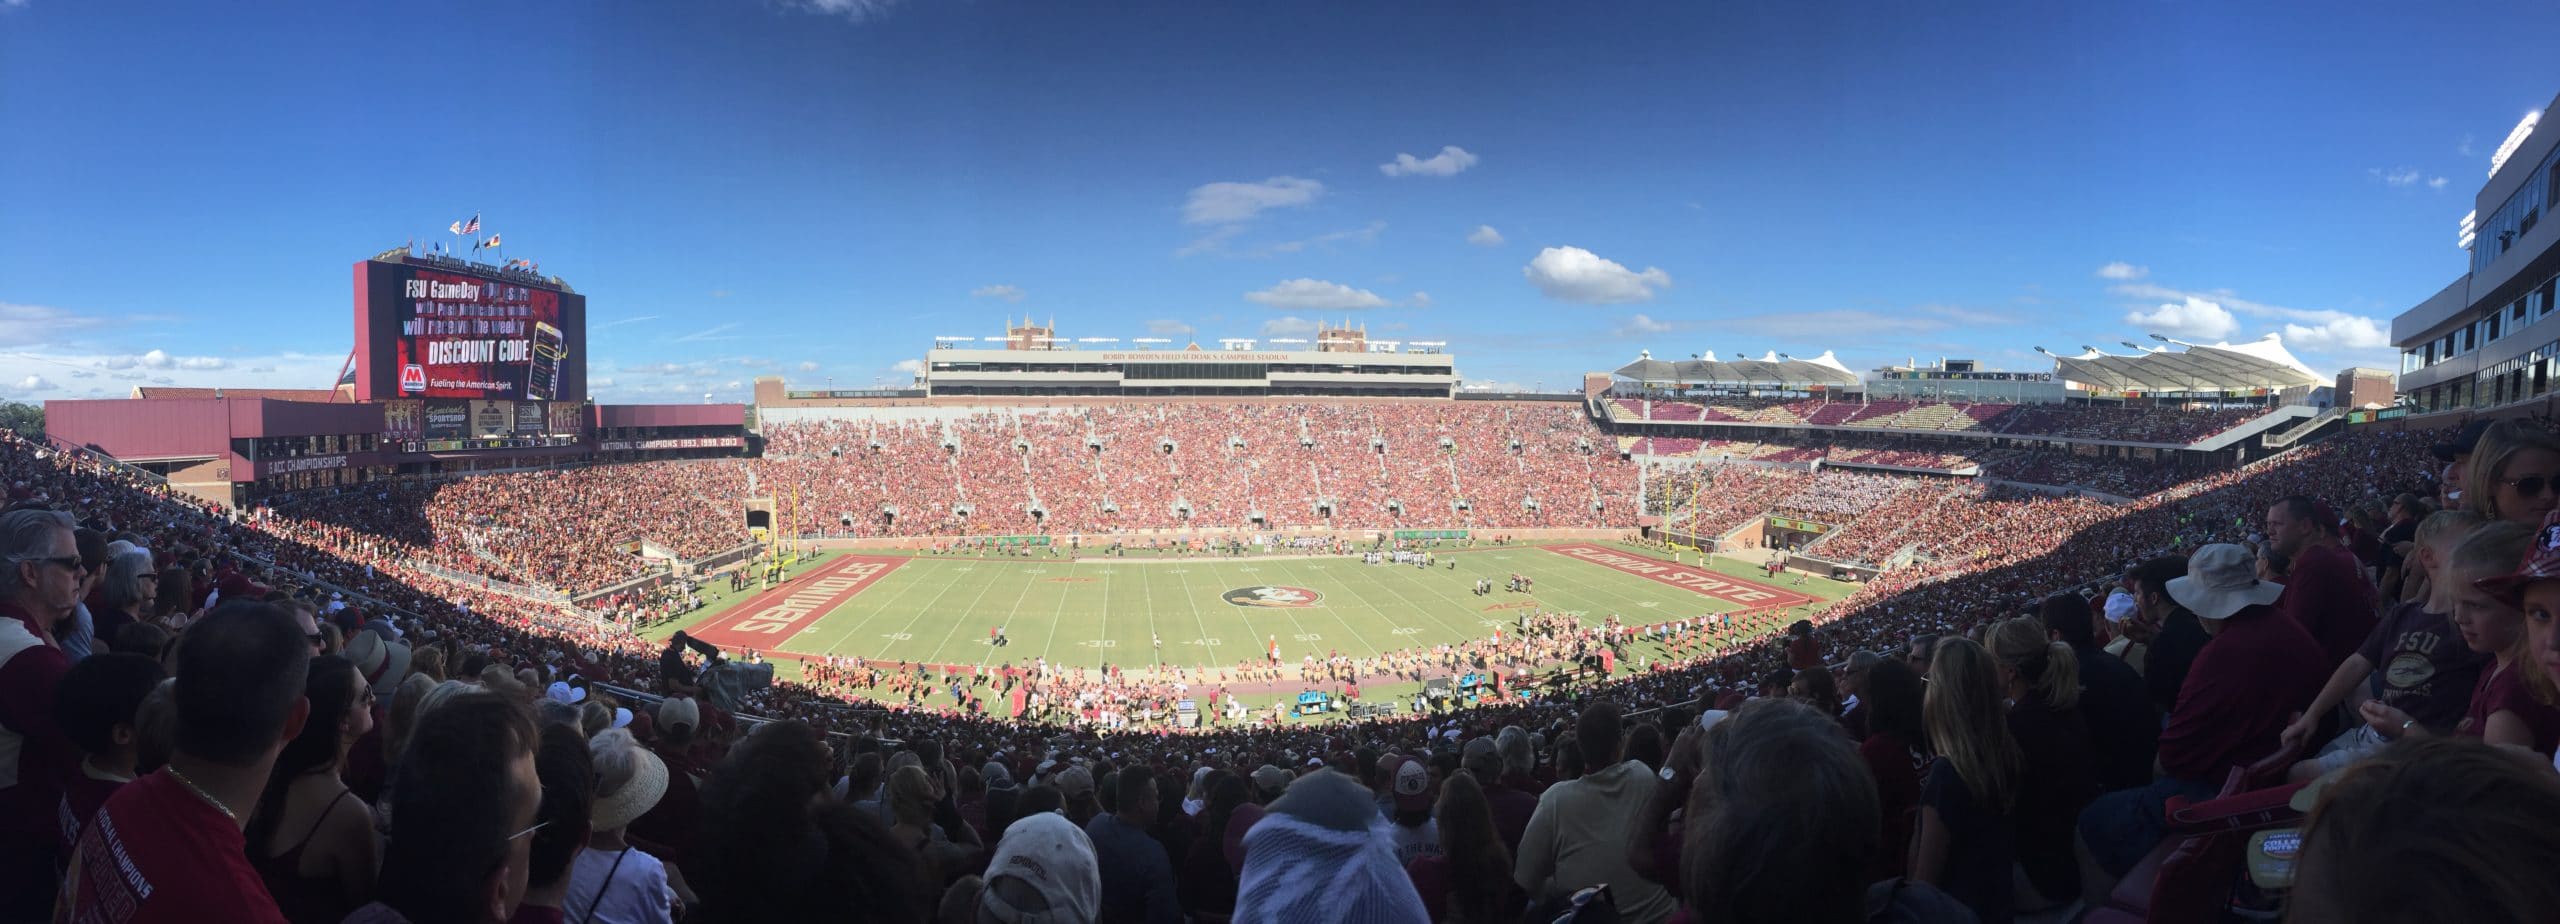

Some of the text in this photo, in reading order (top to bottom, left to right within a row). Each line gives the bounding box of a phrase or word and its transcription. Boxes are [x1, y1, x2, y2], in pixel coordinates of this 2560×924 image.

[427, 253, 468, 272] FLORIDA
[471, 261, 499, 278] STATE
[406, 280, 427, 298] FSU
[430, 280, 480, 302] GameDay
[404, 317, 525, 336] will receive the weekly
[428, 340, 529, 365] DISCOUNT CODE
[405, 368, 422, 382] M
[430, 379, 512, 390] Fueling the American Spirit.
[430, 414, 466, 423] SPORTSHOP
[601, 440, 632, 450] NATIONAL
[636, 439, 678, 450] CHAMPIONS
[680, 438, 698, 448] 1993,
[720, 438, 737, 446] 2013
[274, 460, 285, 474] ACC
[288, 456, 347, 472] CHAMPIONSHIPS
[1565, 548, 1777, 602] FLORIDA STATE
[730, 562, 888, 634] SEMINOLES
[1088, 640, 1116, 648] 30
[1194, 638, 1222, 646] 40
[2393, 632, 2440, 655] FSU
[112, 838, 154, 900] CHAMPIONS
